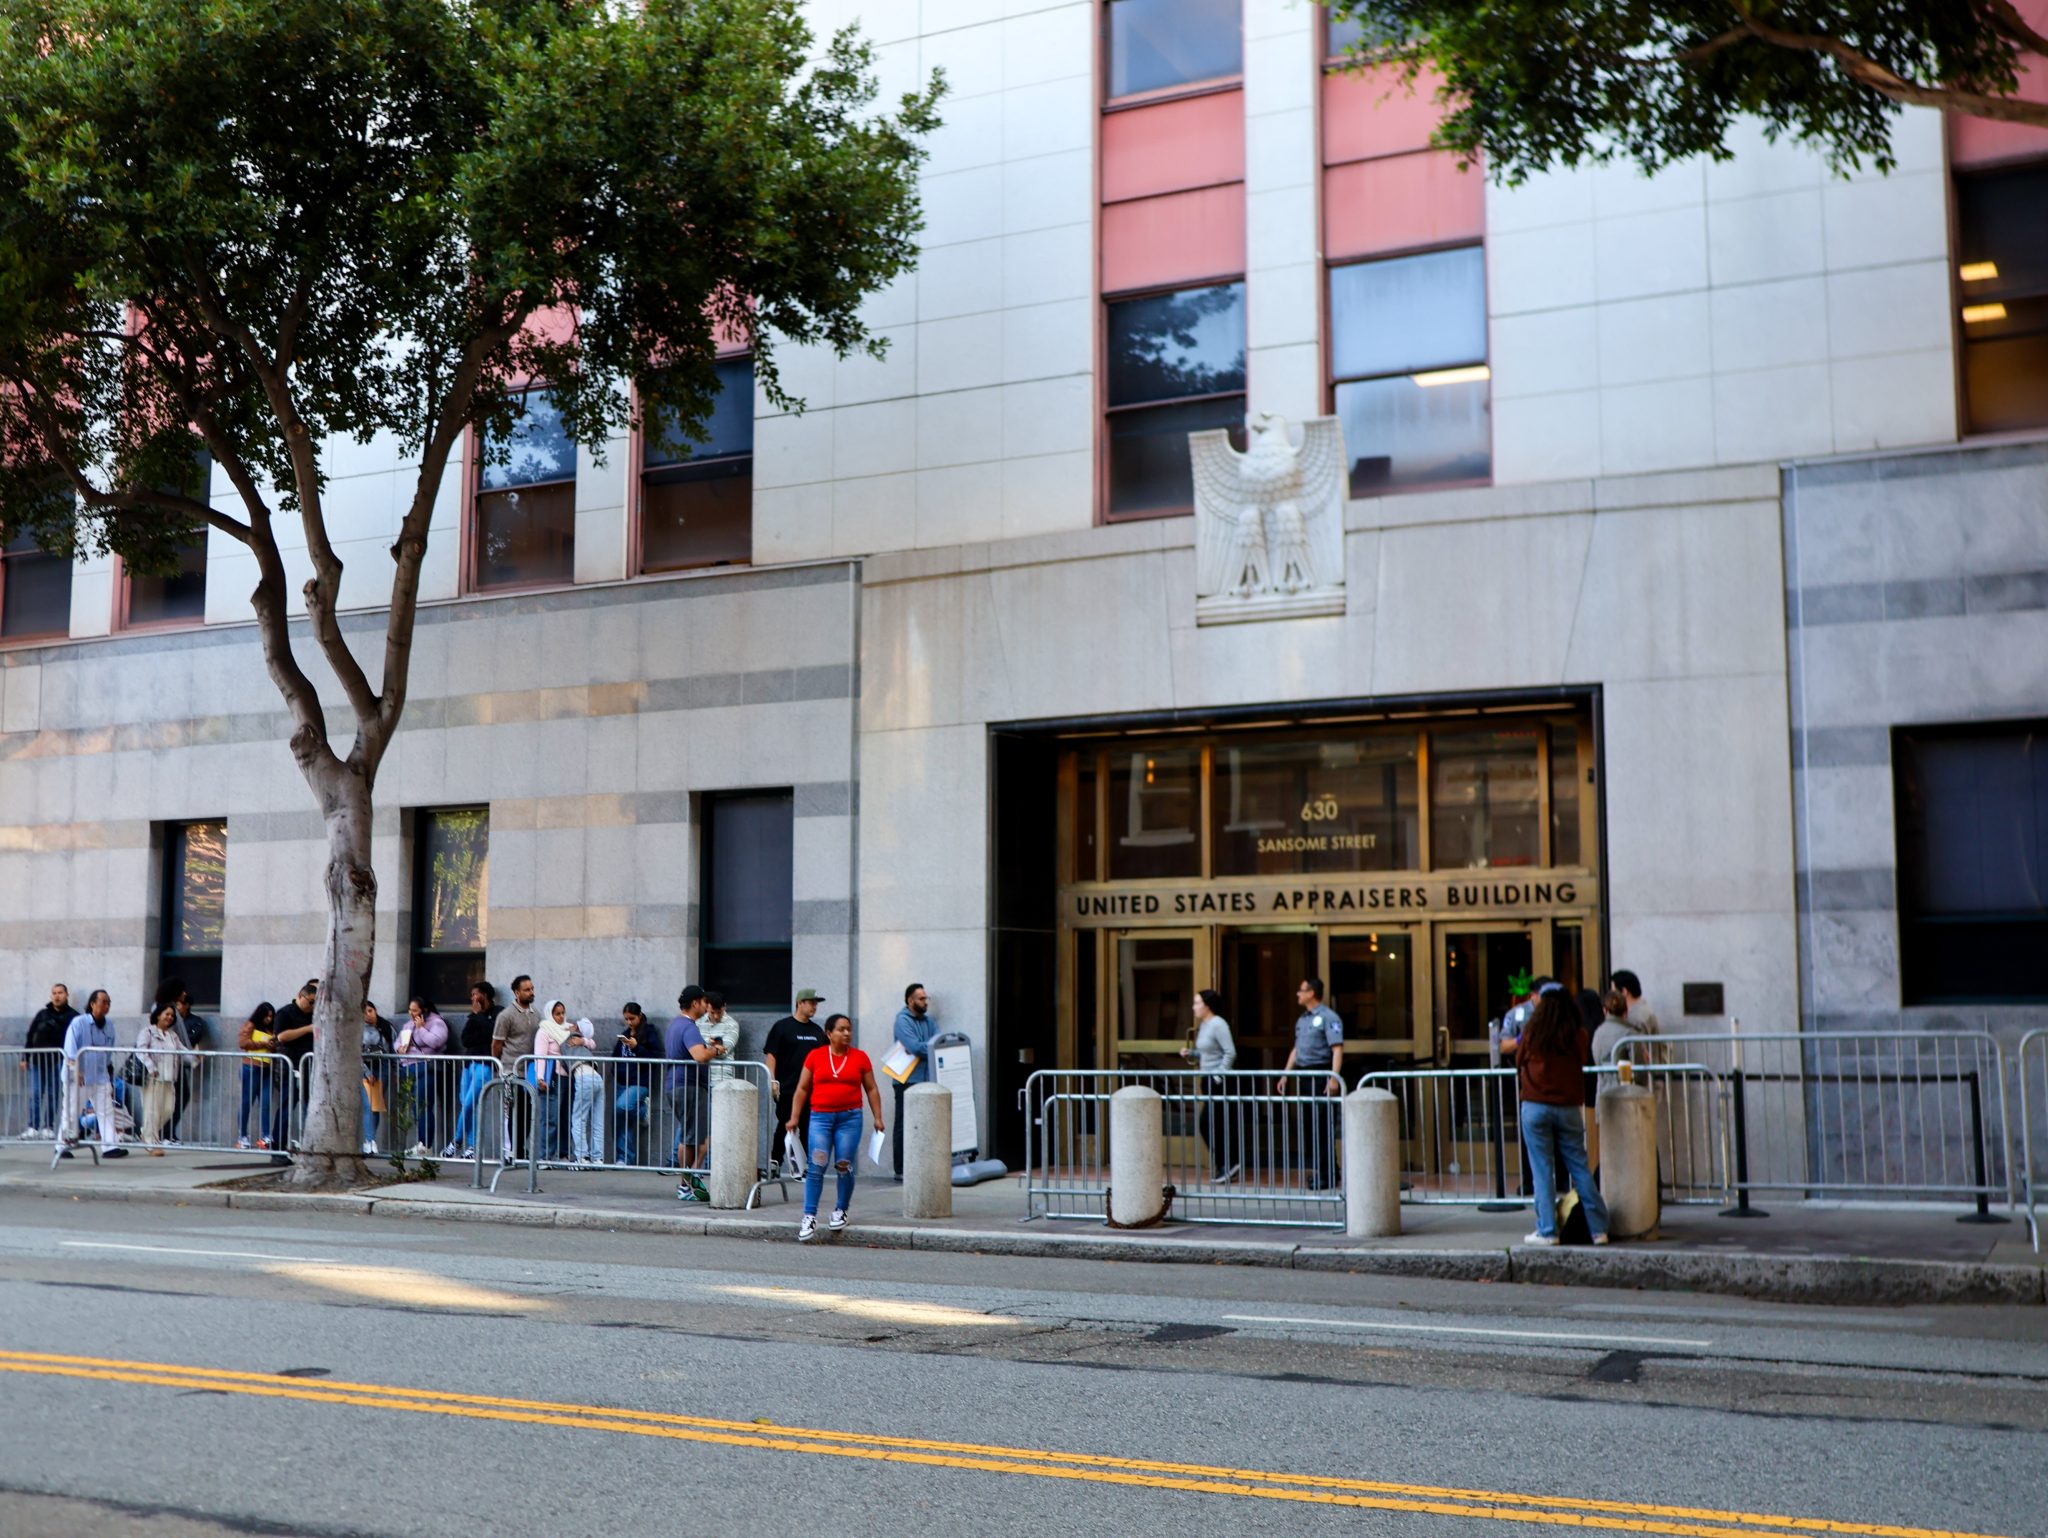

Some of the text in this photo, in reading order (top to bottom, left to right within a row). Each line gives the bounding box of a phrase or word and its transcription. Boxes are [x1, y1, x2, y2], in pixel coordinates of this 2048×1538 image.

[1301, 800, 1338, 821] 630
[1257, 834, 1376, 853] SANSOME STREET
[1077, 883, 1577, 915] UNITED STATES APPRAISERS BUILDING
